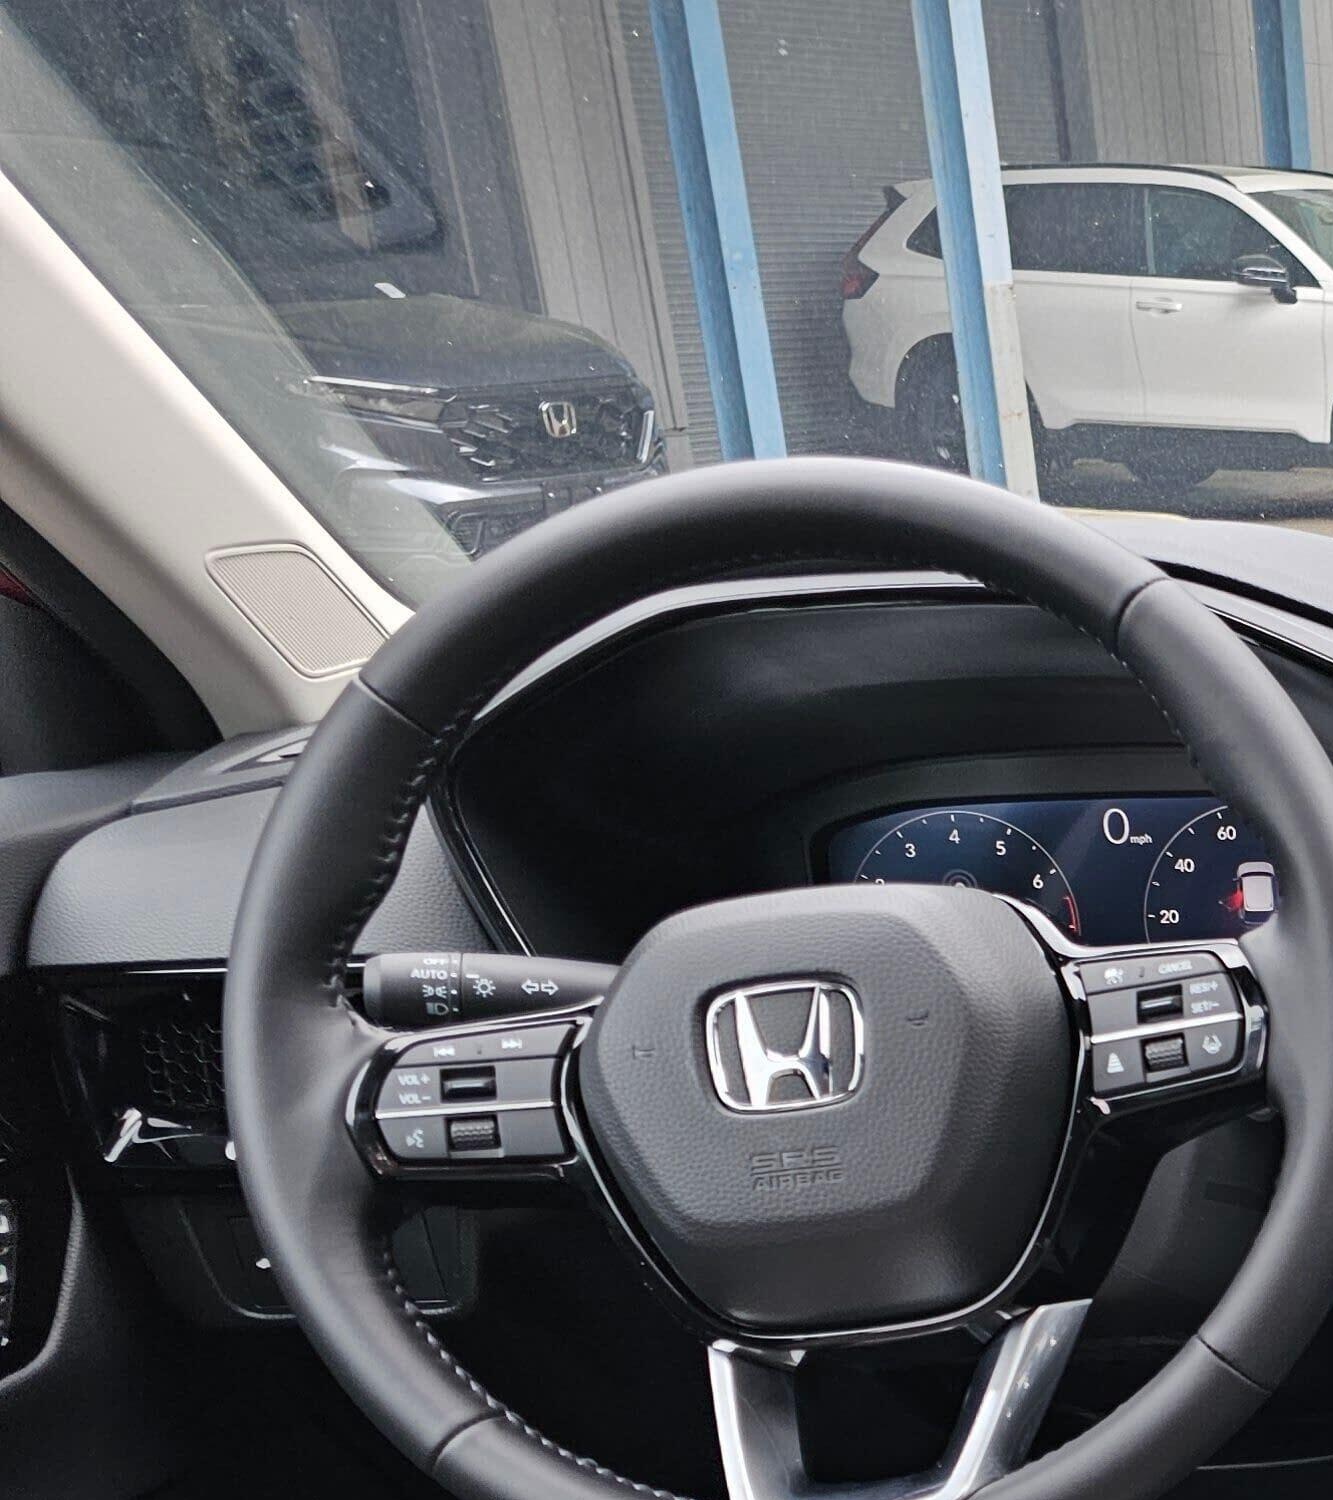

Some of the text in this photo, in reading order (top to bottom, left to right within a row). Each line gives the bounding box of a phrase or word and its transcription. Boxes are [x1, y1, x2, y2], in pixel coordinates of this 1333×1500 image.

[1103, 808, 1152, 845] 0 mph
[1217, 826, 1237, 841] 60
[949, 829, 960, 844] 4
[905, 843, 916, 858] 3
[995, 841, 1006, 856] 5
[1174, 858, 1195, 873] 40
[1032, 874, 1043, 889] 6
[1159, 909, 1180, 924] 20
[410, 968, 448, 980] AUTO
[1158, 960, 1193, 974] CANCEL
